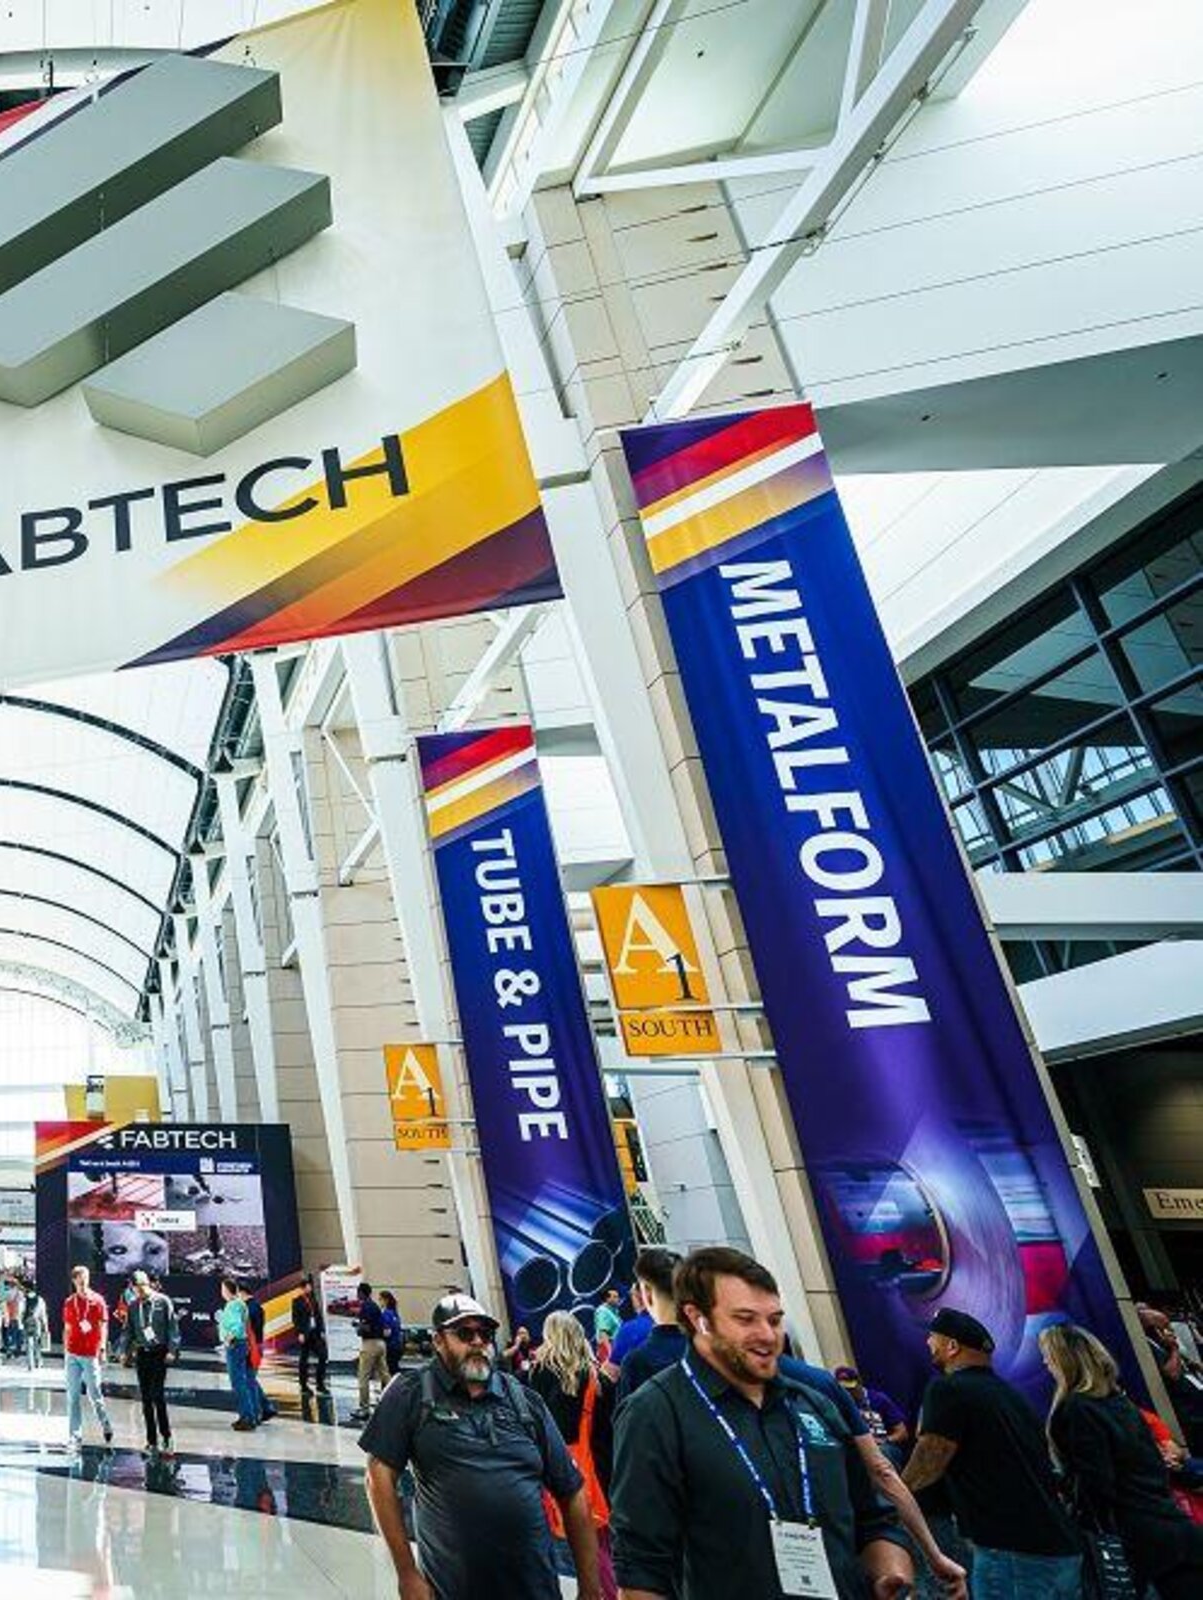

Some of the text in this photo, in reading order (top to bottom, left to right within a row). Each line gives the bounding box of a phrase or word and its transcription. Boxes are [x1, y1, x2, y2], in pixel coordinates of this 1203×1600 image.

[718, 559, 932, 1029] METALFORM
[470, 828, 568, 1142] TUBE & PIPE
[629, 1019, 713, 1039] SOUTH
[120, 1130, 237, 1149] FABTECH
[397, 1128, 446, 1139] SOUTH
